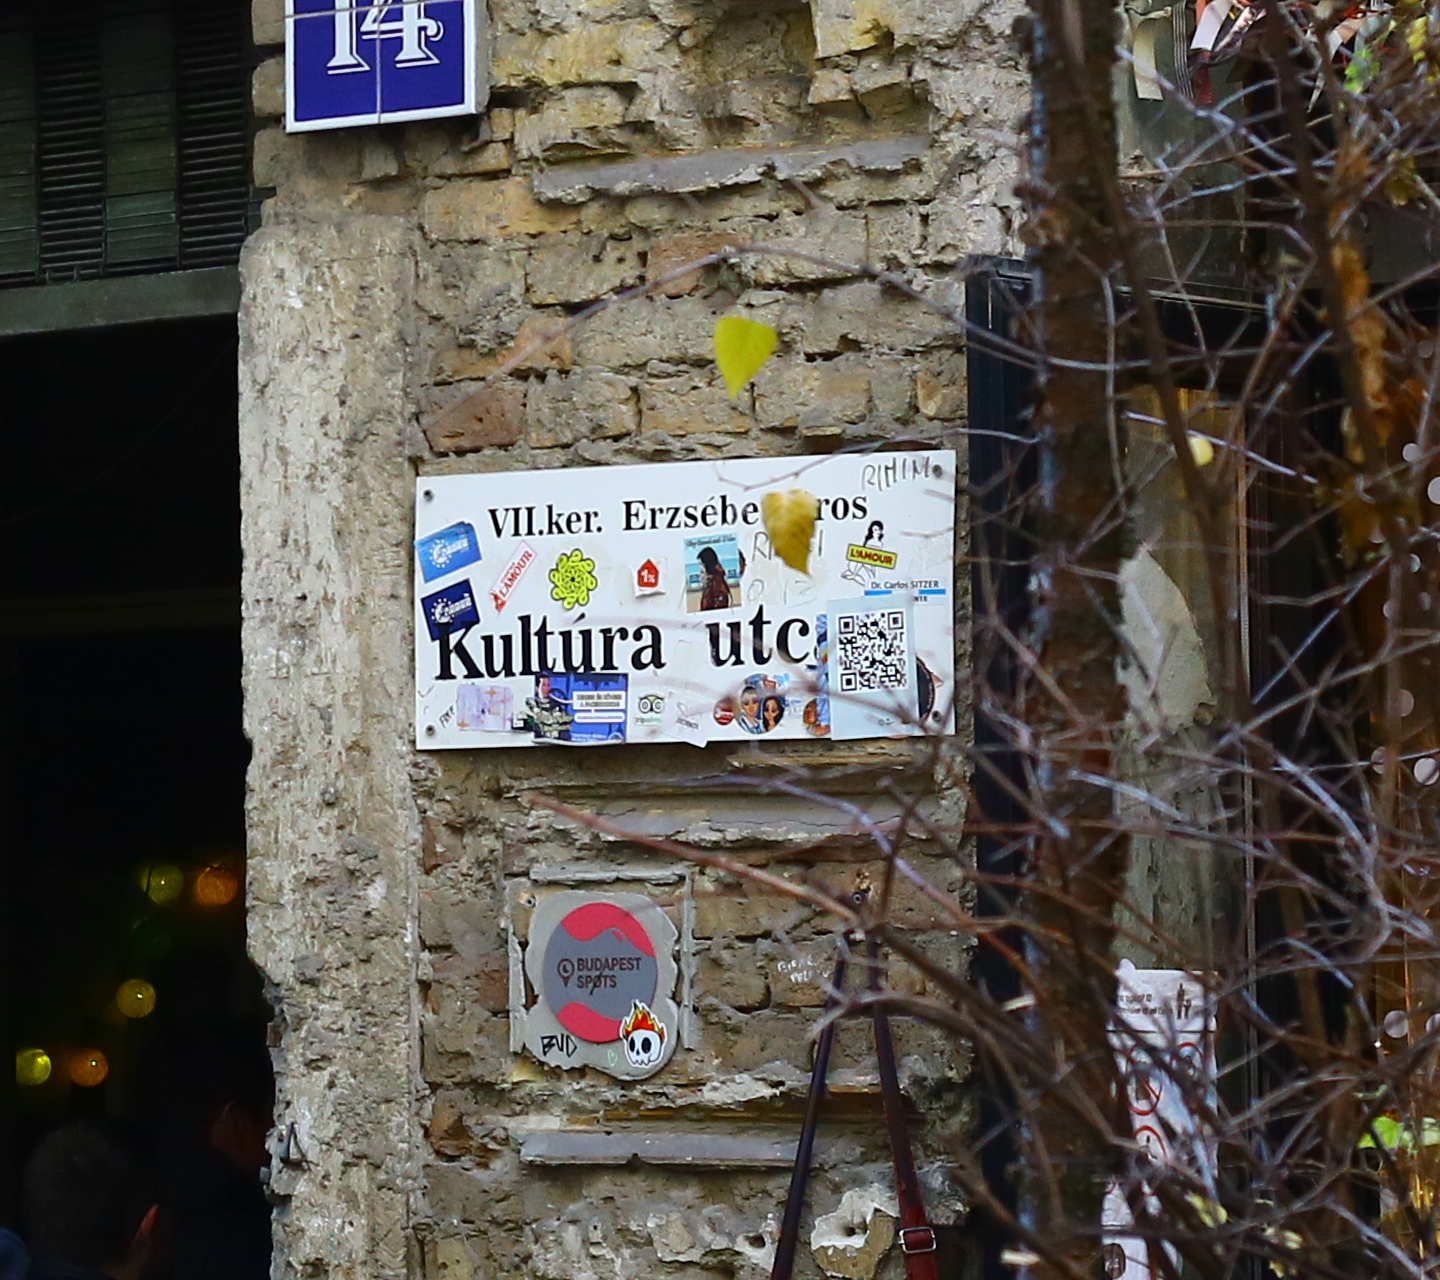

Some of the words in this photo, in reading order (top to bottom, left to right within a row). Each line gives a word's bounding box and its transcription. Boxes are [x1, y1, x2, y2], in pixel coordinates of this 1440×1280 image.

[488, 504, 604, 539] VII.ker.
[622, 494, 867, 531] Erzséberos
[436, 613, 665, 680] Kultúra
[577, 957, 642, 971] BUDAPEST
